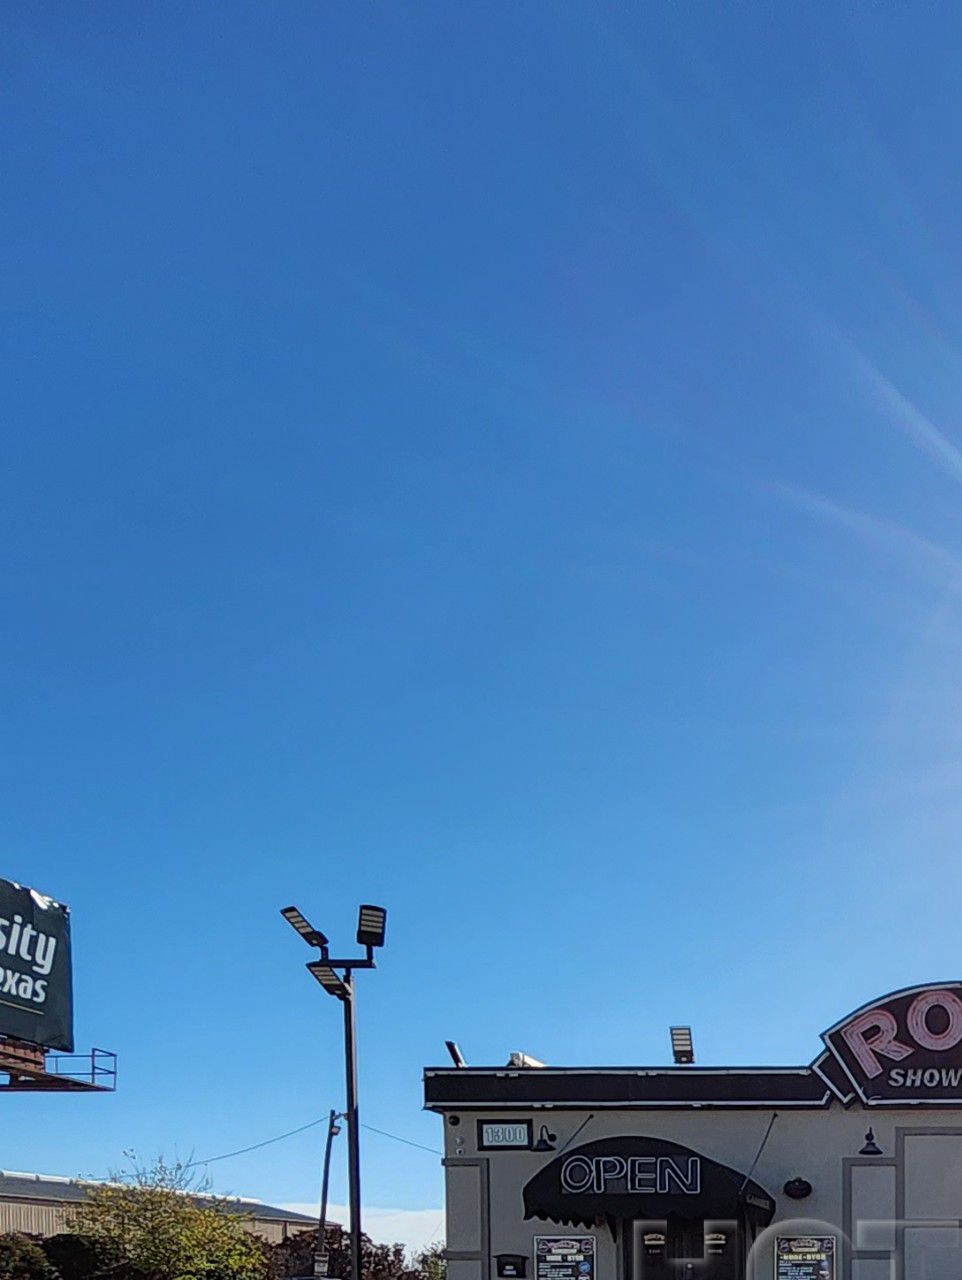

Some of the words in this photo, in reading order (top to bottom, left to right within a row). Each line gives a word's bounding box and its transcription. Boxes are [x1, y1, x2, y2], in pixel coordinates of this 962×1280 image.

[0, 966, 48, 1003] xas
[485, 1126, 526, 1143] 1300
[560, 1154, 701, 1195] OPEN
